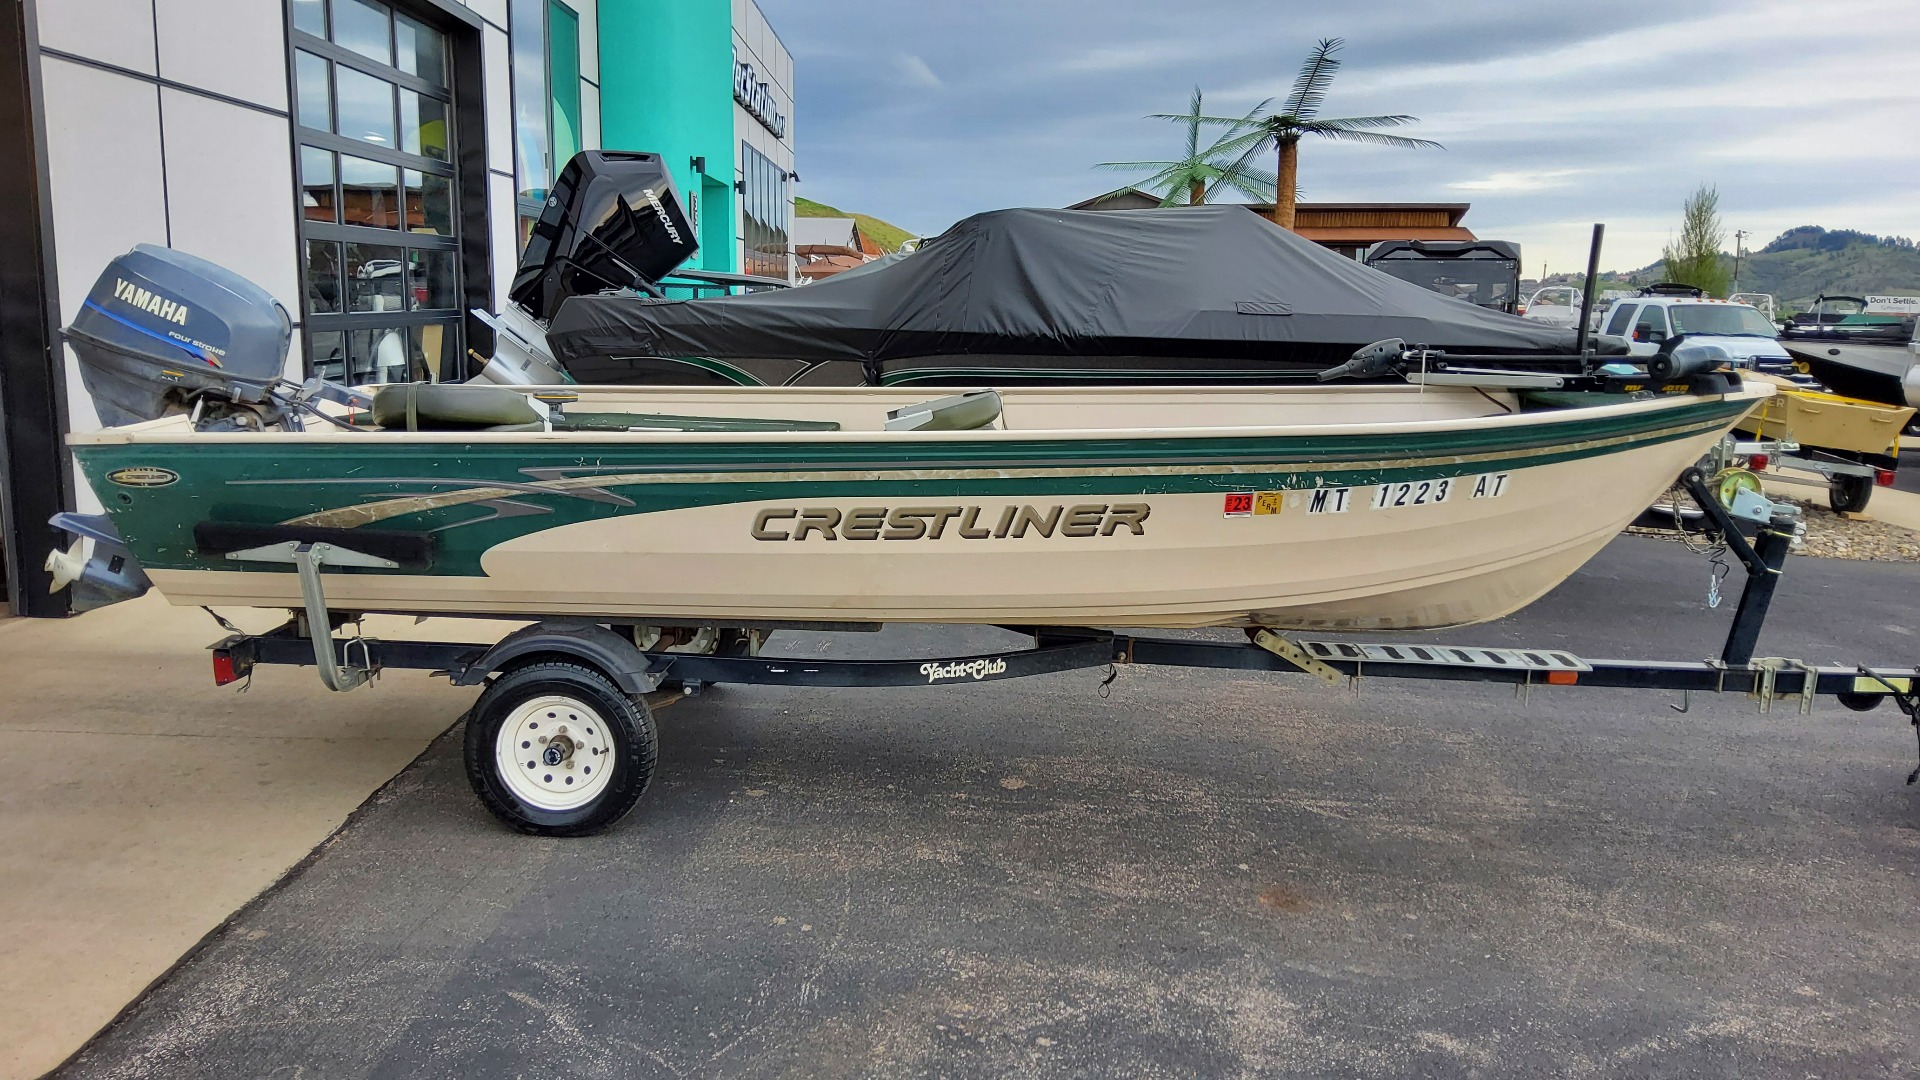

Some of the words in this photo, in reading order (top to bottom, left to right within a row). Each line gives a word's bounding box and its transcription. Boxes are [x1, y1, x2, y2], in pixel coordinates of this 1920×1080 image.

[643, 189, 683, 244] MERCURY
[114, 278, 187, 326] YAMAHA
[1233, 497, 1251, 511] 23
[1309, 488, 1348, 513] MT
[1379, 480, 1449, 507] 1223
[1474, 474, 1507, 498] AT
[751, 503, 1151, 541] CRESTLINER
[966, 658, 1006, 679] Club
